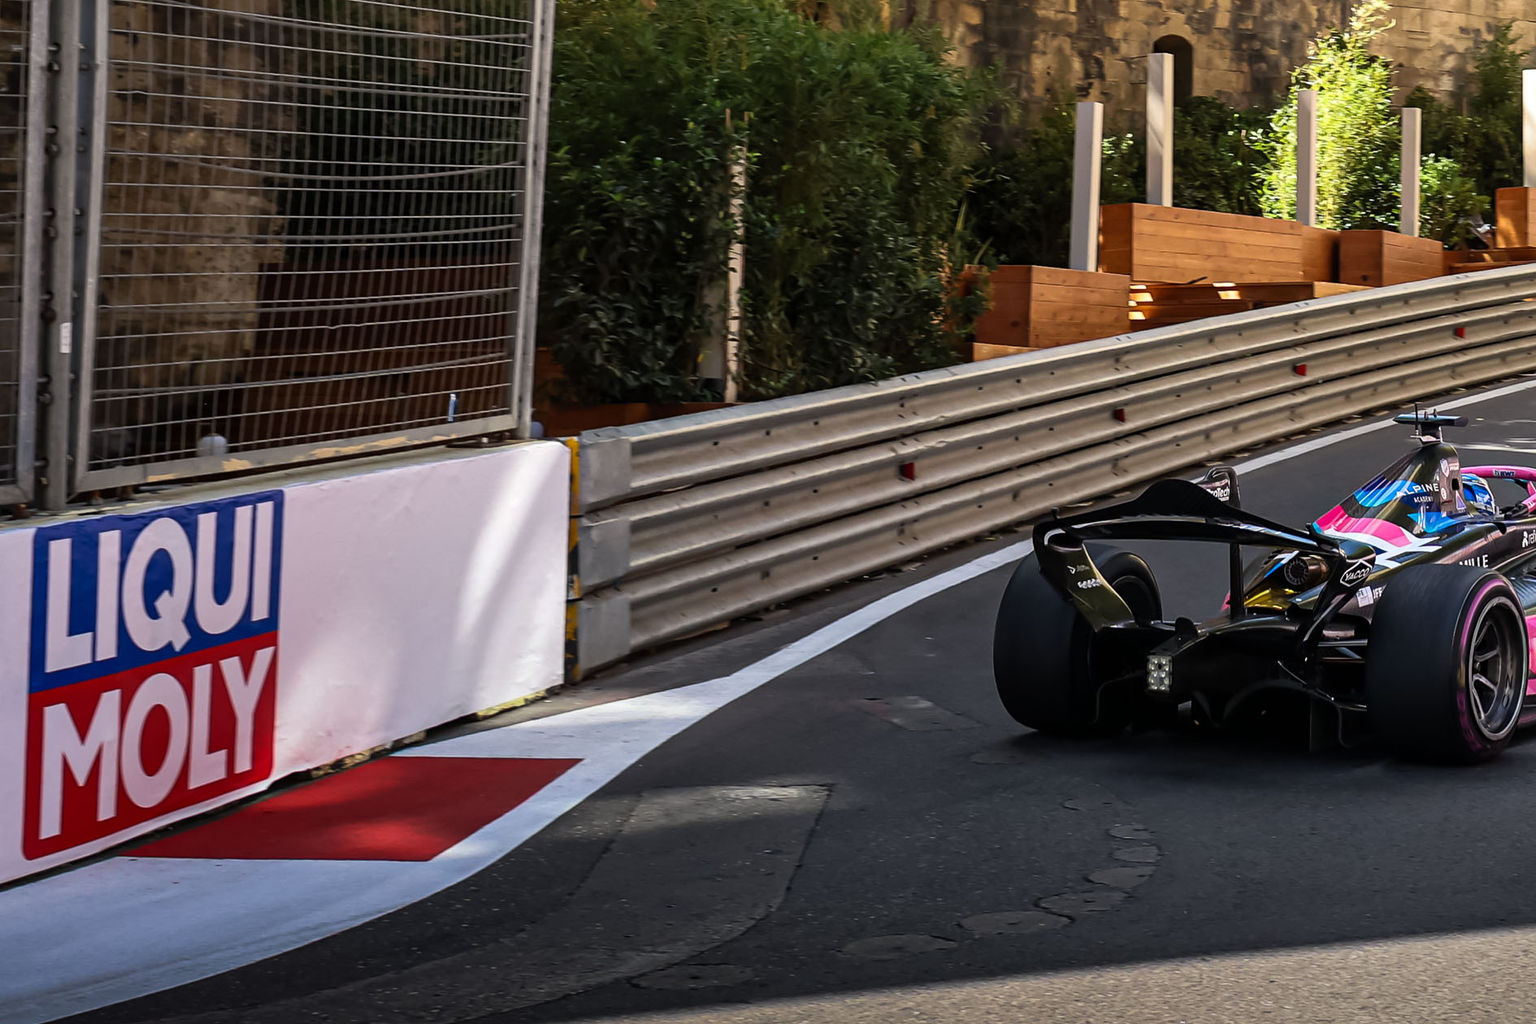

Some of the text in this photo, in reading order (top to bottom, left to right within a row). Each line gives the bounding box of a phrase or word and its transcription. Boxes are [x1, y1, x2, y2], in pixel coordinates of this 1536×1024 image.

[1396, 483, 1440, 498] ALPINE
[45, 501, 274, 673] LIQUI
[1344, 567, 1370, 582] YACCO
[39, 645, 276, 840] MOLY
